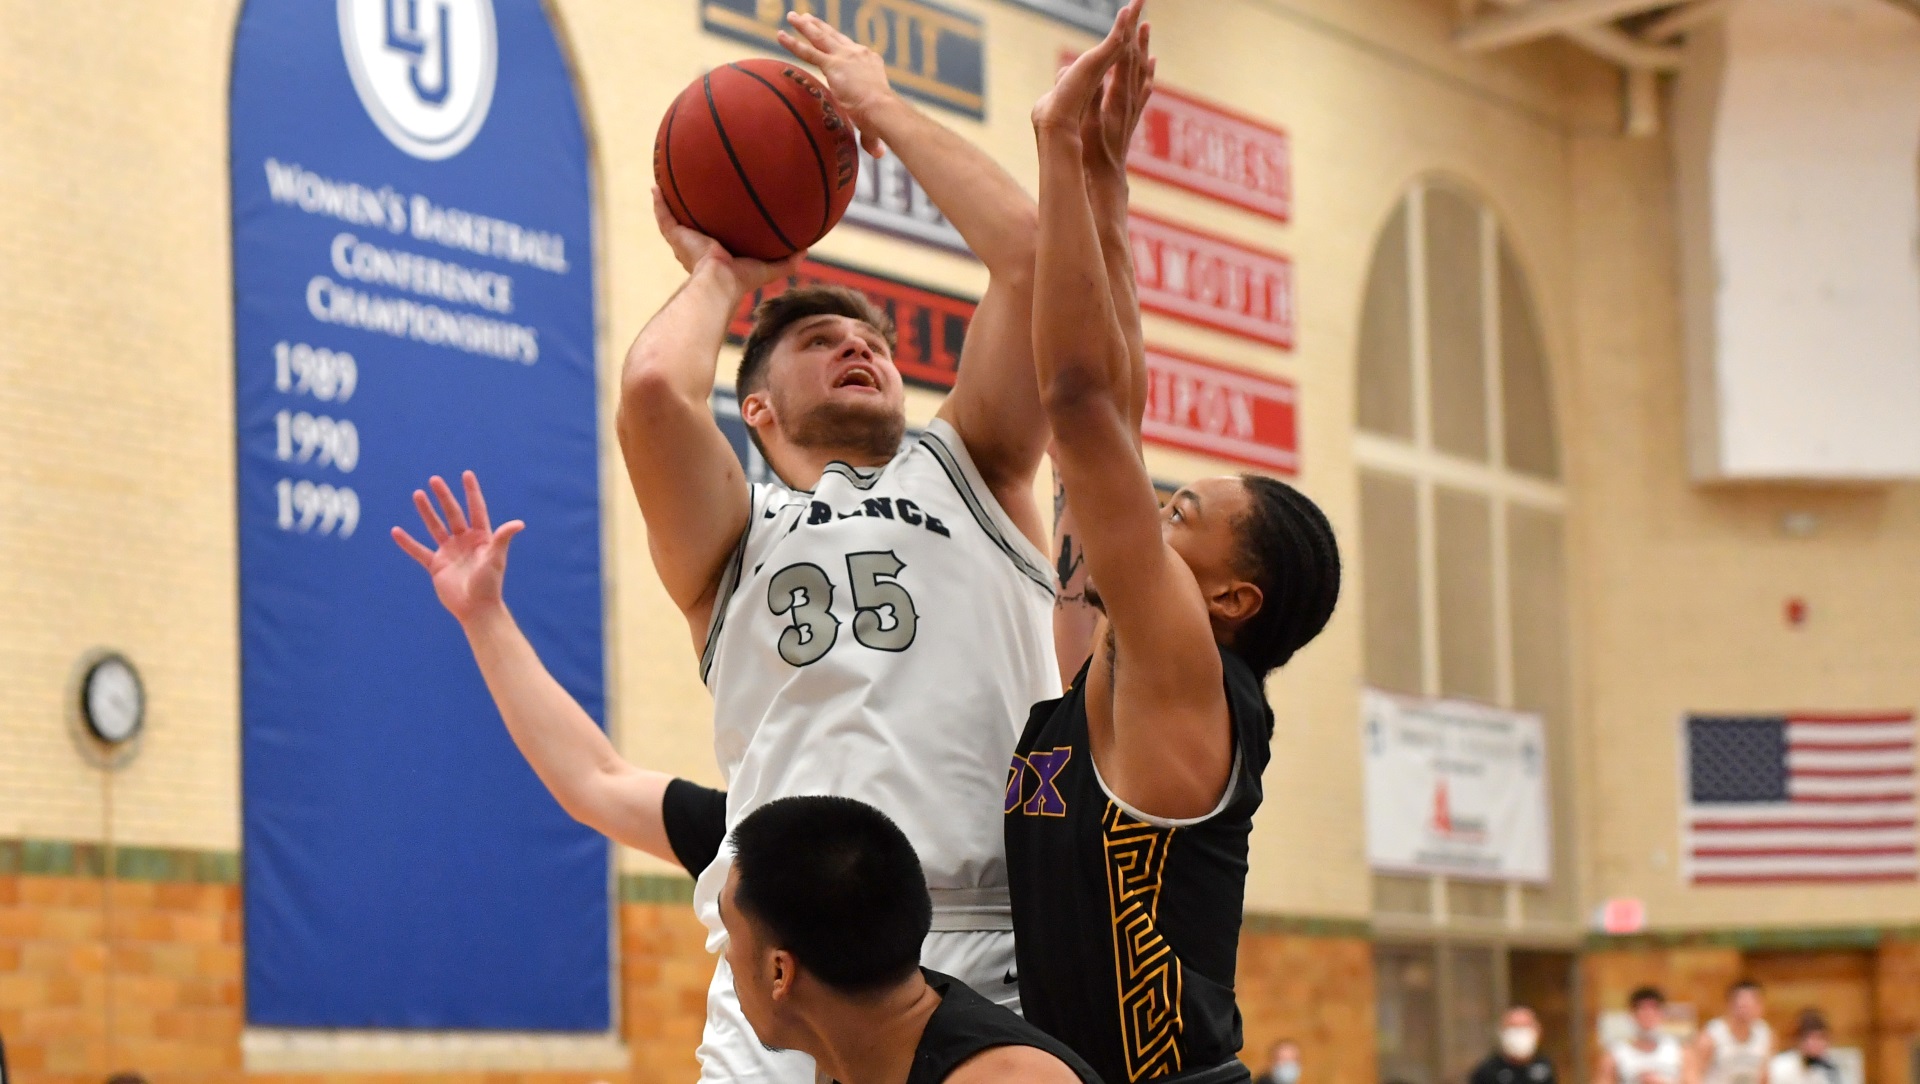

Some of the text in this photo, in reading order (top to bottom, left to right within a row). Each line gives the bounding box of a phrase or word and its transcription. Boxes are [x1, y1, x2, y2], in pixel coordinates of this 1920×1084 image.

[264, 158, 570, 274] WOMEN'S BASKETBALL
[331, 233, 513, 314] CONFERENCE
[306, 276, 539, 365] CHAMPIONSHIPS
[274, 341, 358, 402] 1989
[274, 410, 359, 473] 1990
[276, 478, 360, 539] 1999
[767, 550, 920, 667] 35
